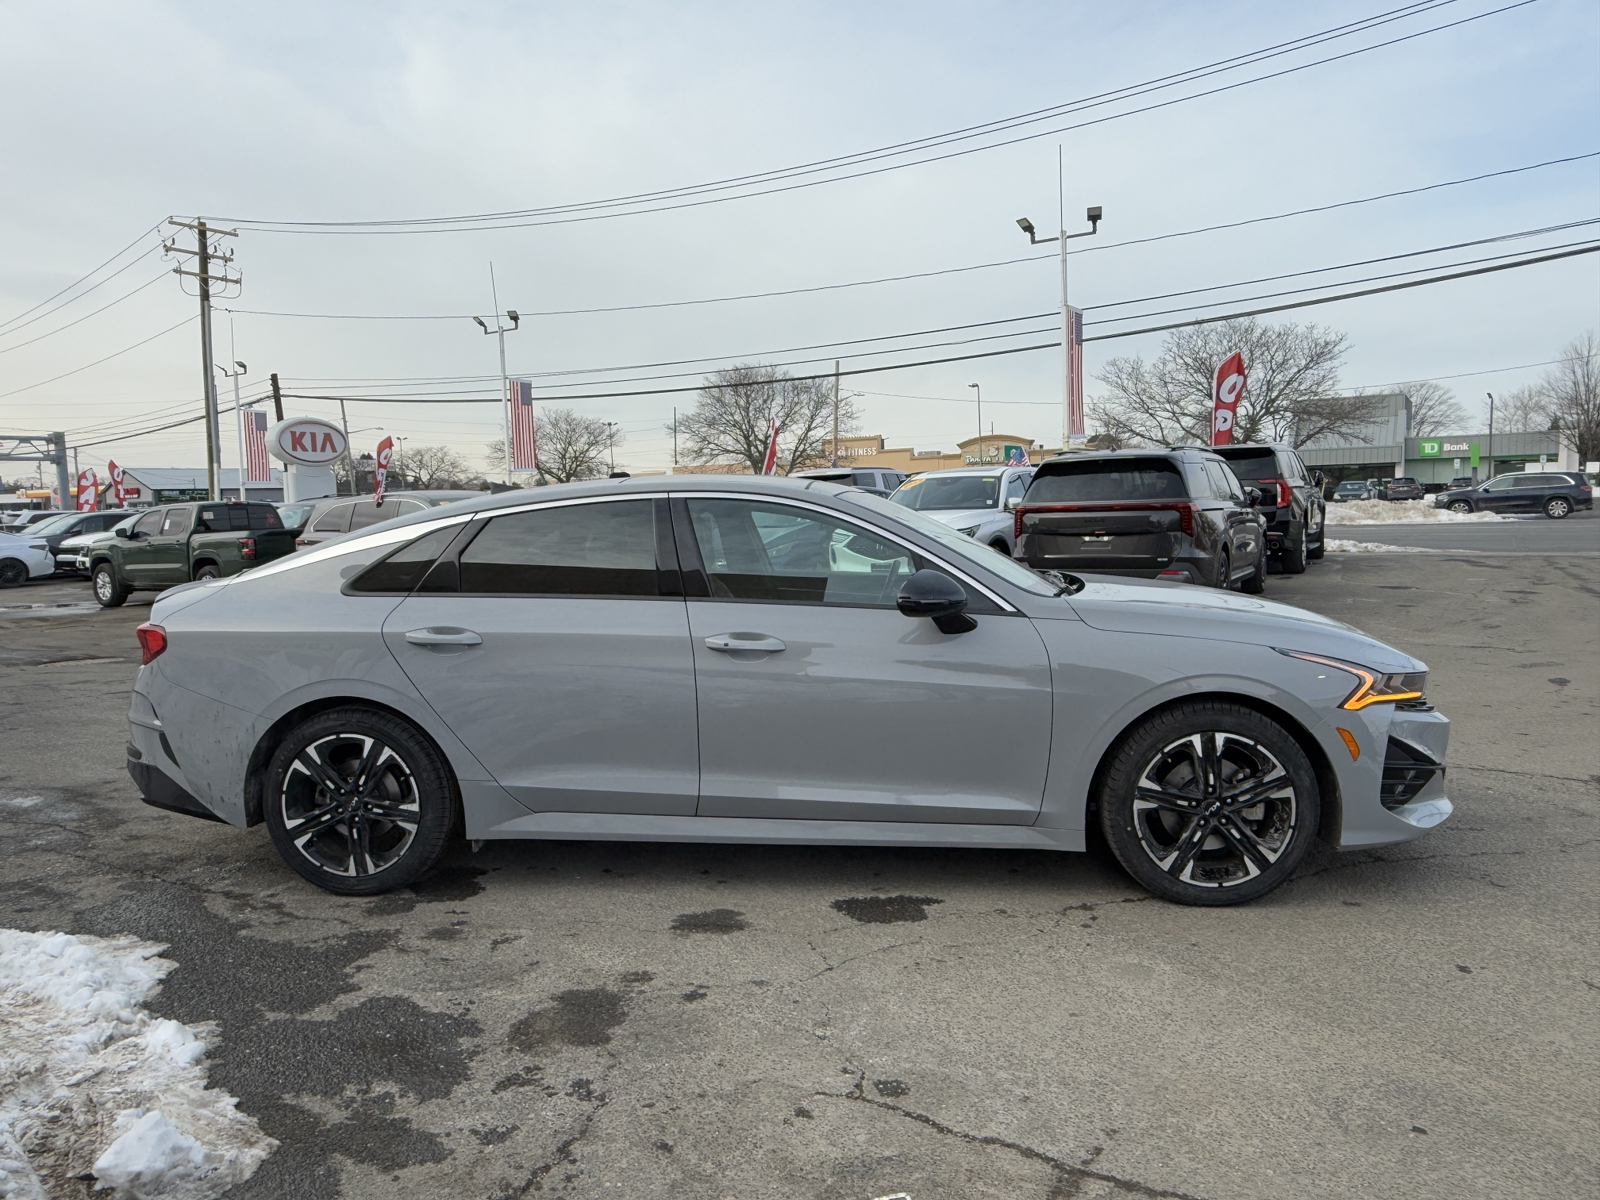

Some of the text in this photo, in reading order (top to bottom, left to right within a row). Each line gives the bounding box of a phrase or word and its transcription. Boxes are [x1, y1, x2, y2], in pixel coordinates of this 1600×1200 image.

[289, 431, 338, 453] KIA
[848, 447, 877, 456] FITNESS
[1422, 443, 1469, 453] TD Bank
